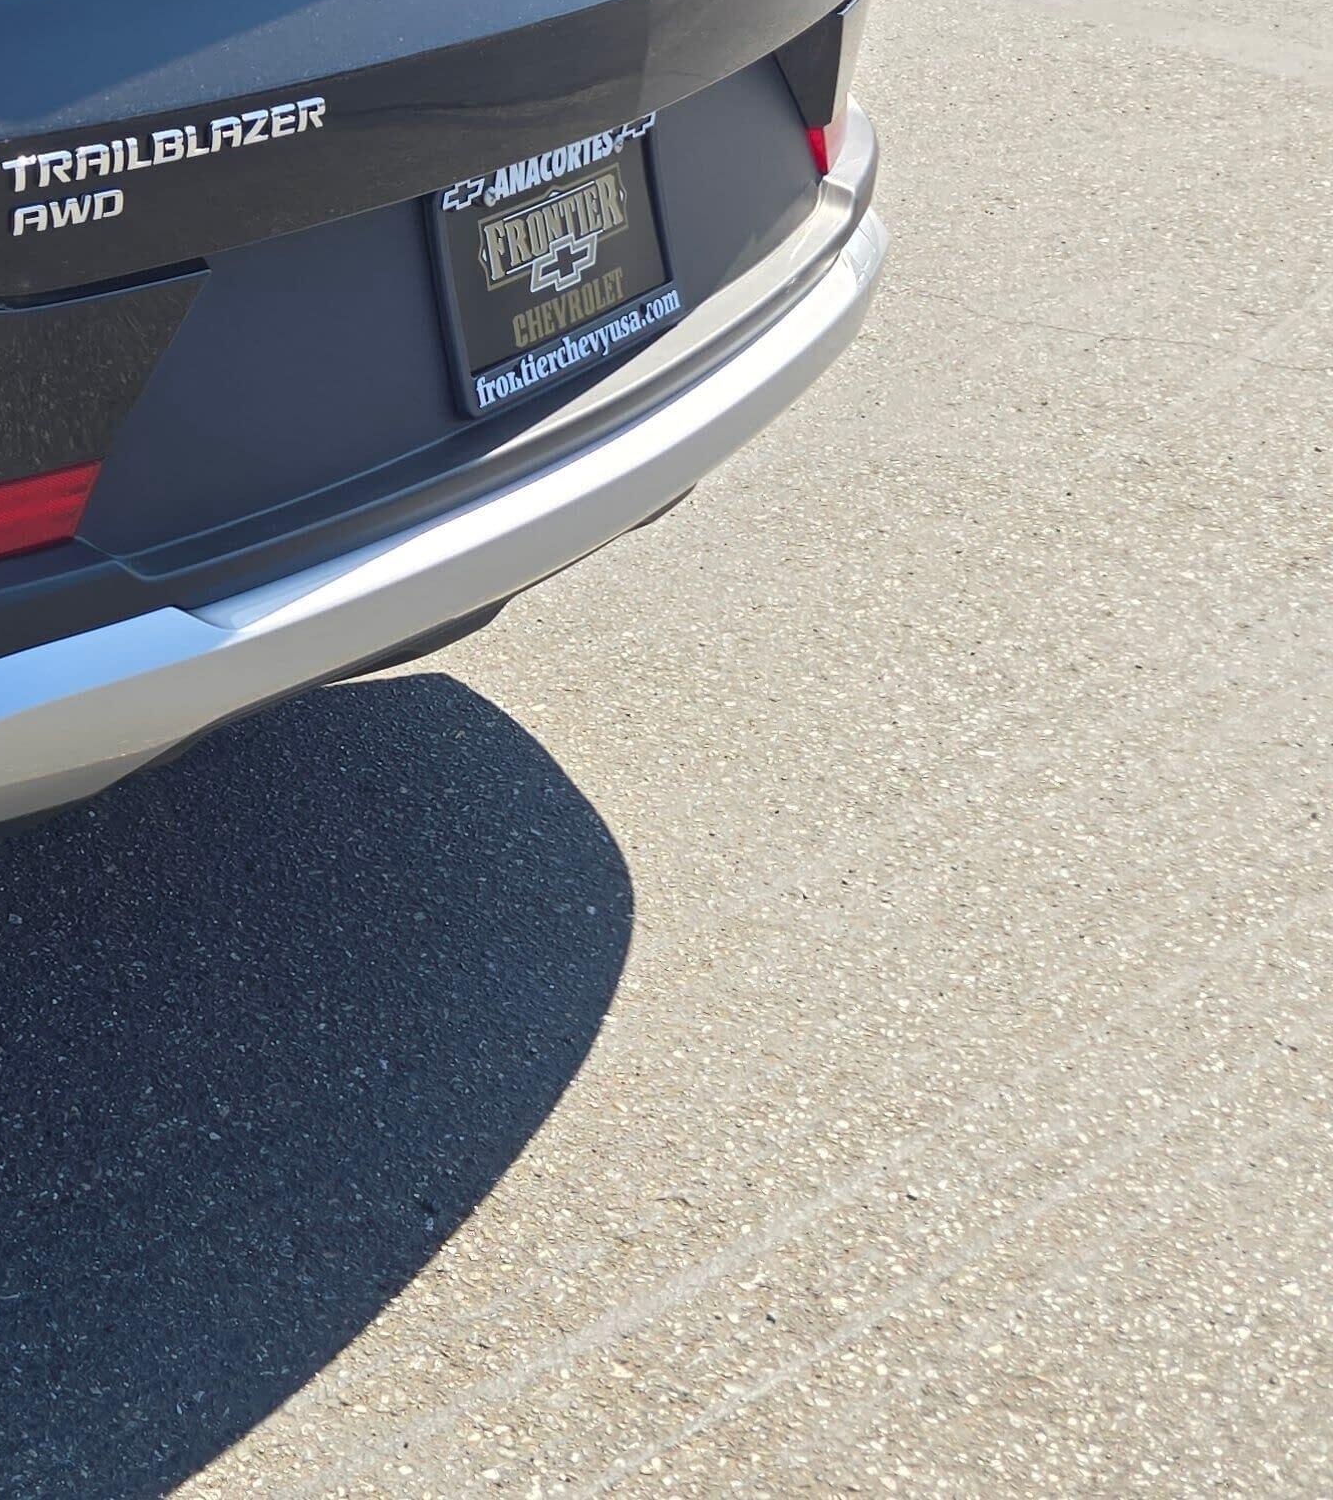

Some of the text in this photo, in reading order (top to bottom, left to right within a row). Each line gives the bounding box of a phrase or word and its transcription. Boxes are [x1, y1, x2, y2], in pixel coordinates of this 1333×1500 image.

[2, 97, 326, 192] TRAILBLAZER
[495, 131, 613, 199] ANACORTES
[13, 189, 124, 236] AWD
[484, 173, 625, 280] FRONTIER
[512, 267, 623, 348] CHEVROLET
